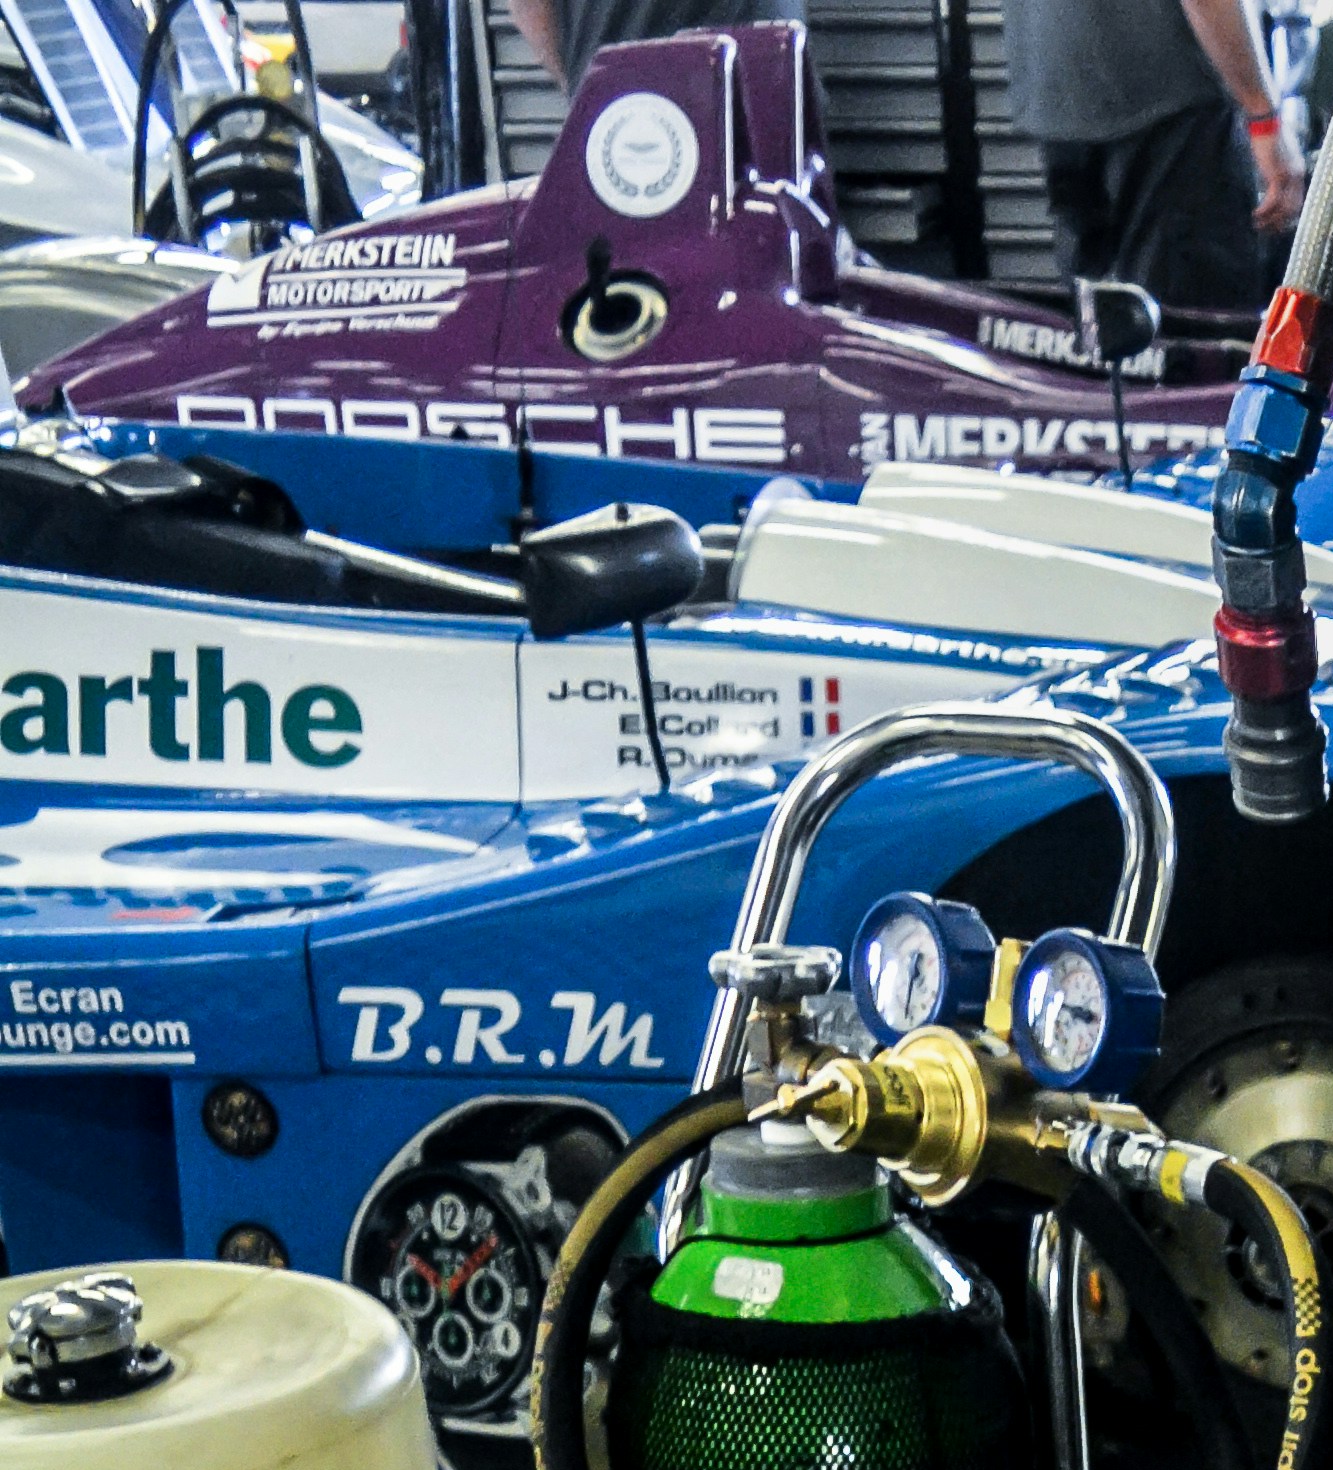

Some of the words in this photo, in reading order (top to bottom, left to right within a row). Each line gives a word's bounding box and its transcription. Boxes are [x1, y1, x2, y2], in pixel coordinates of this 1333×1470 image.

[0, 645, 363, 769] arthe
[10, 979, 124, 1014] Ecran
[0, 1020, 191, 1054] unge.com
[337, 985, 665, 1069] B.R.M
